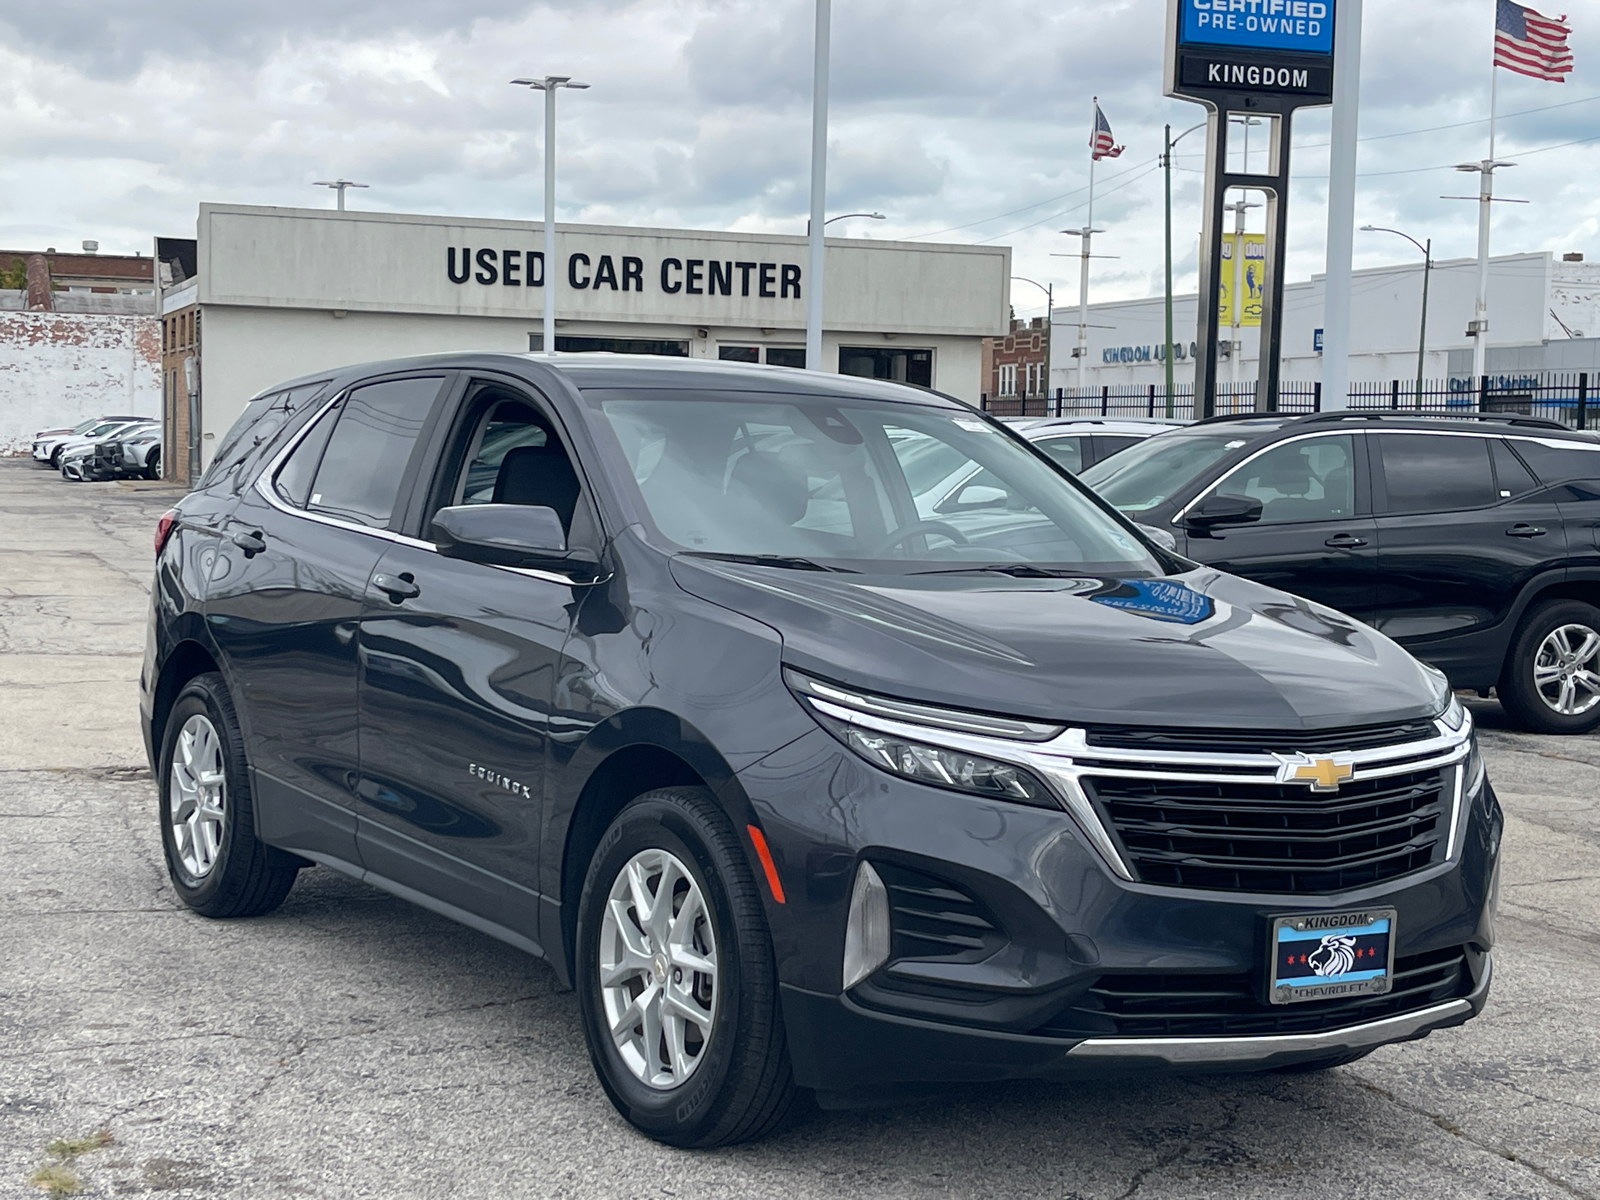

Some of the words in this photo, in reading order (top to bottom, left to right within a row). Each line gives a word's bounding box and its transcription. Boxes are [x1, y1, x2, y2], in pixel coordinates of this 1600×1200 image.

[1193, 0, 1327, 19] CERTIFIED
[1198, 12, 1321, 37] PRE-OWNED
[1208, 63, 1308, 88] KINGDOM
[447, 247, 545, 287] USED
[568, 253, 643, 292] CAR
[660, 258, 801, 299] CENTER
[1102, 345, 1152, 364] KINGDOM
[469, 763, 531, 799] EQUINOX
[1304, 913, 1369, 929] KINGDOM
[1299, 982, 1365, 998] CHEVROLET
